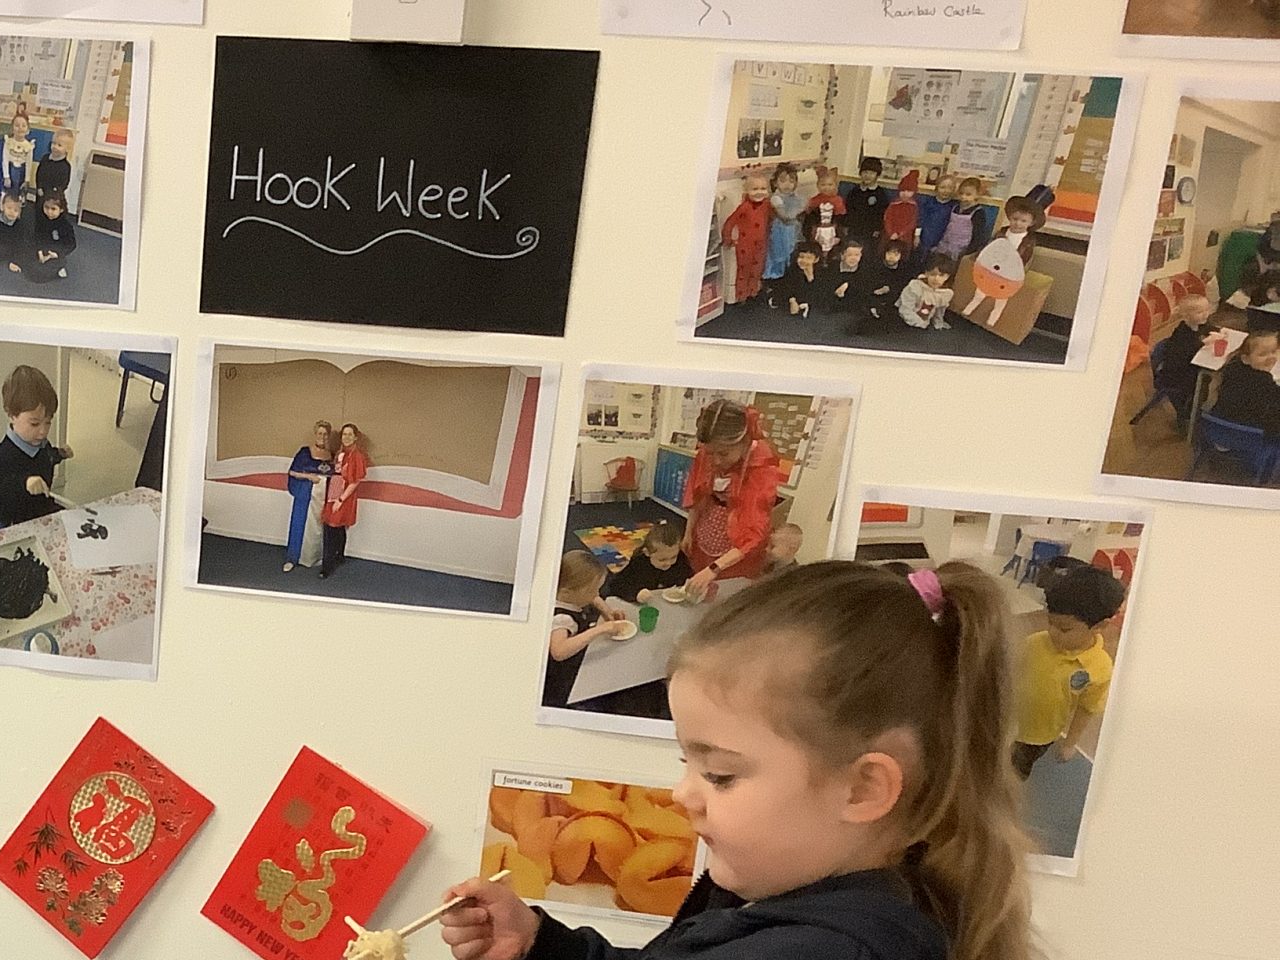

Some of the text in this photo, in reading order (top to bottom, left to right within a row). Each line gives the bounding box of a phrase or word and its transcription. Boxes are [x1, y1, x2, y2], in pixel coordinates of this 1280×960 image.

[503, 776, 563, 789] fortune cookies
[219, 903, 257, 934] HAPPY
[255, 929, 283, 956] NEW
